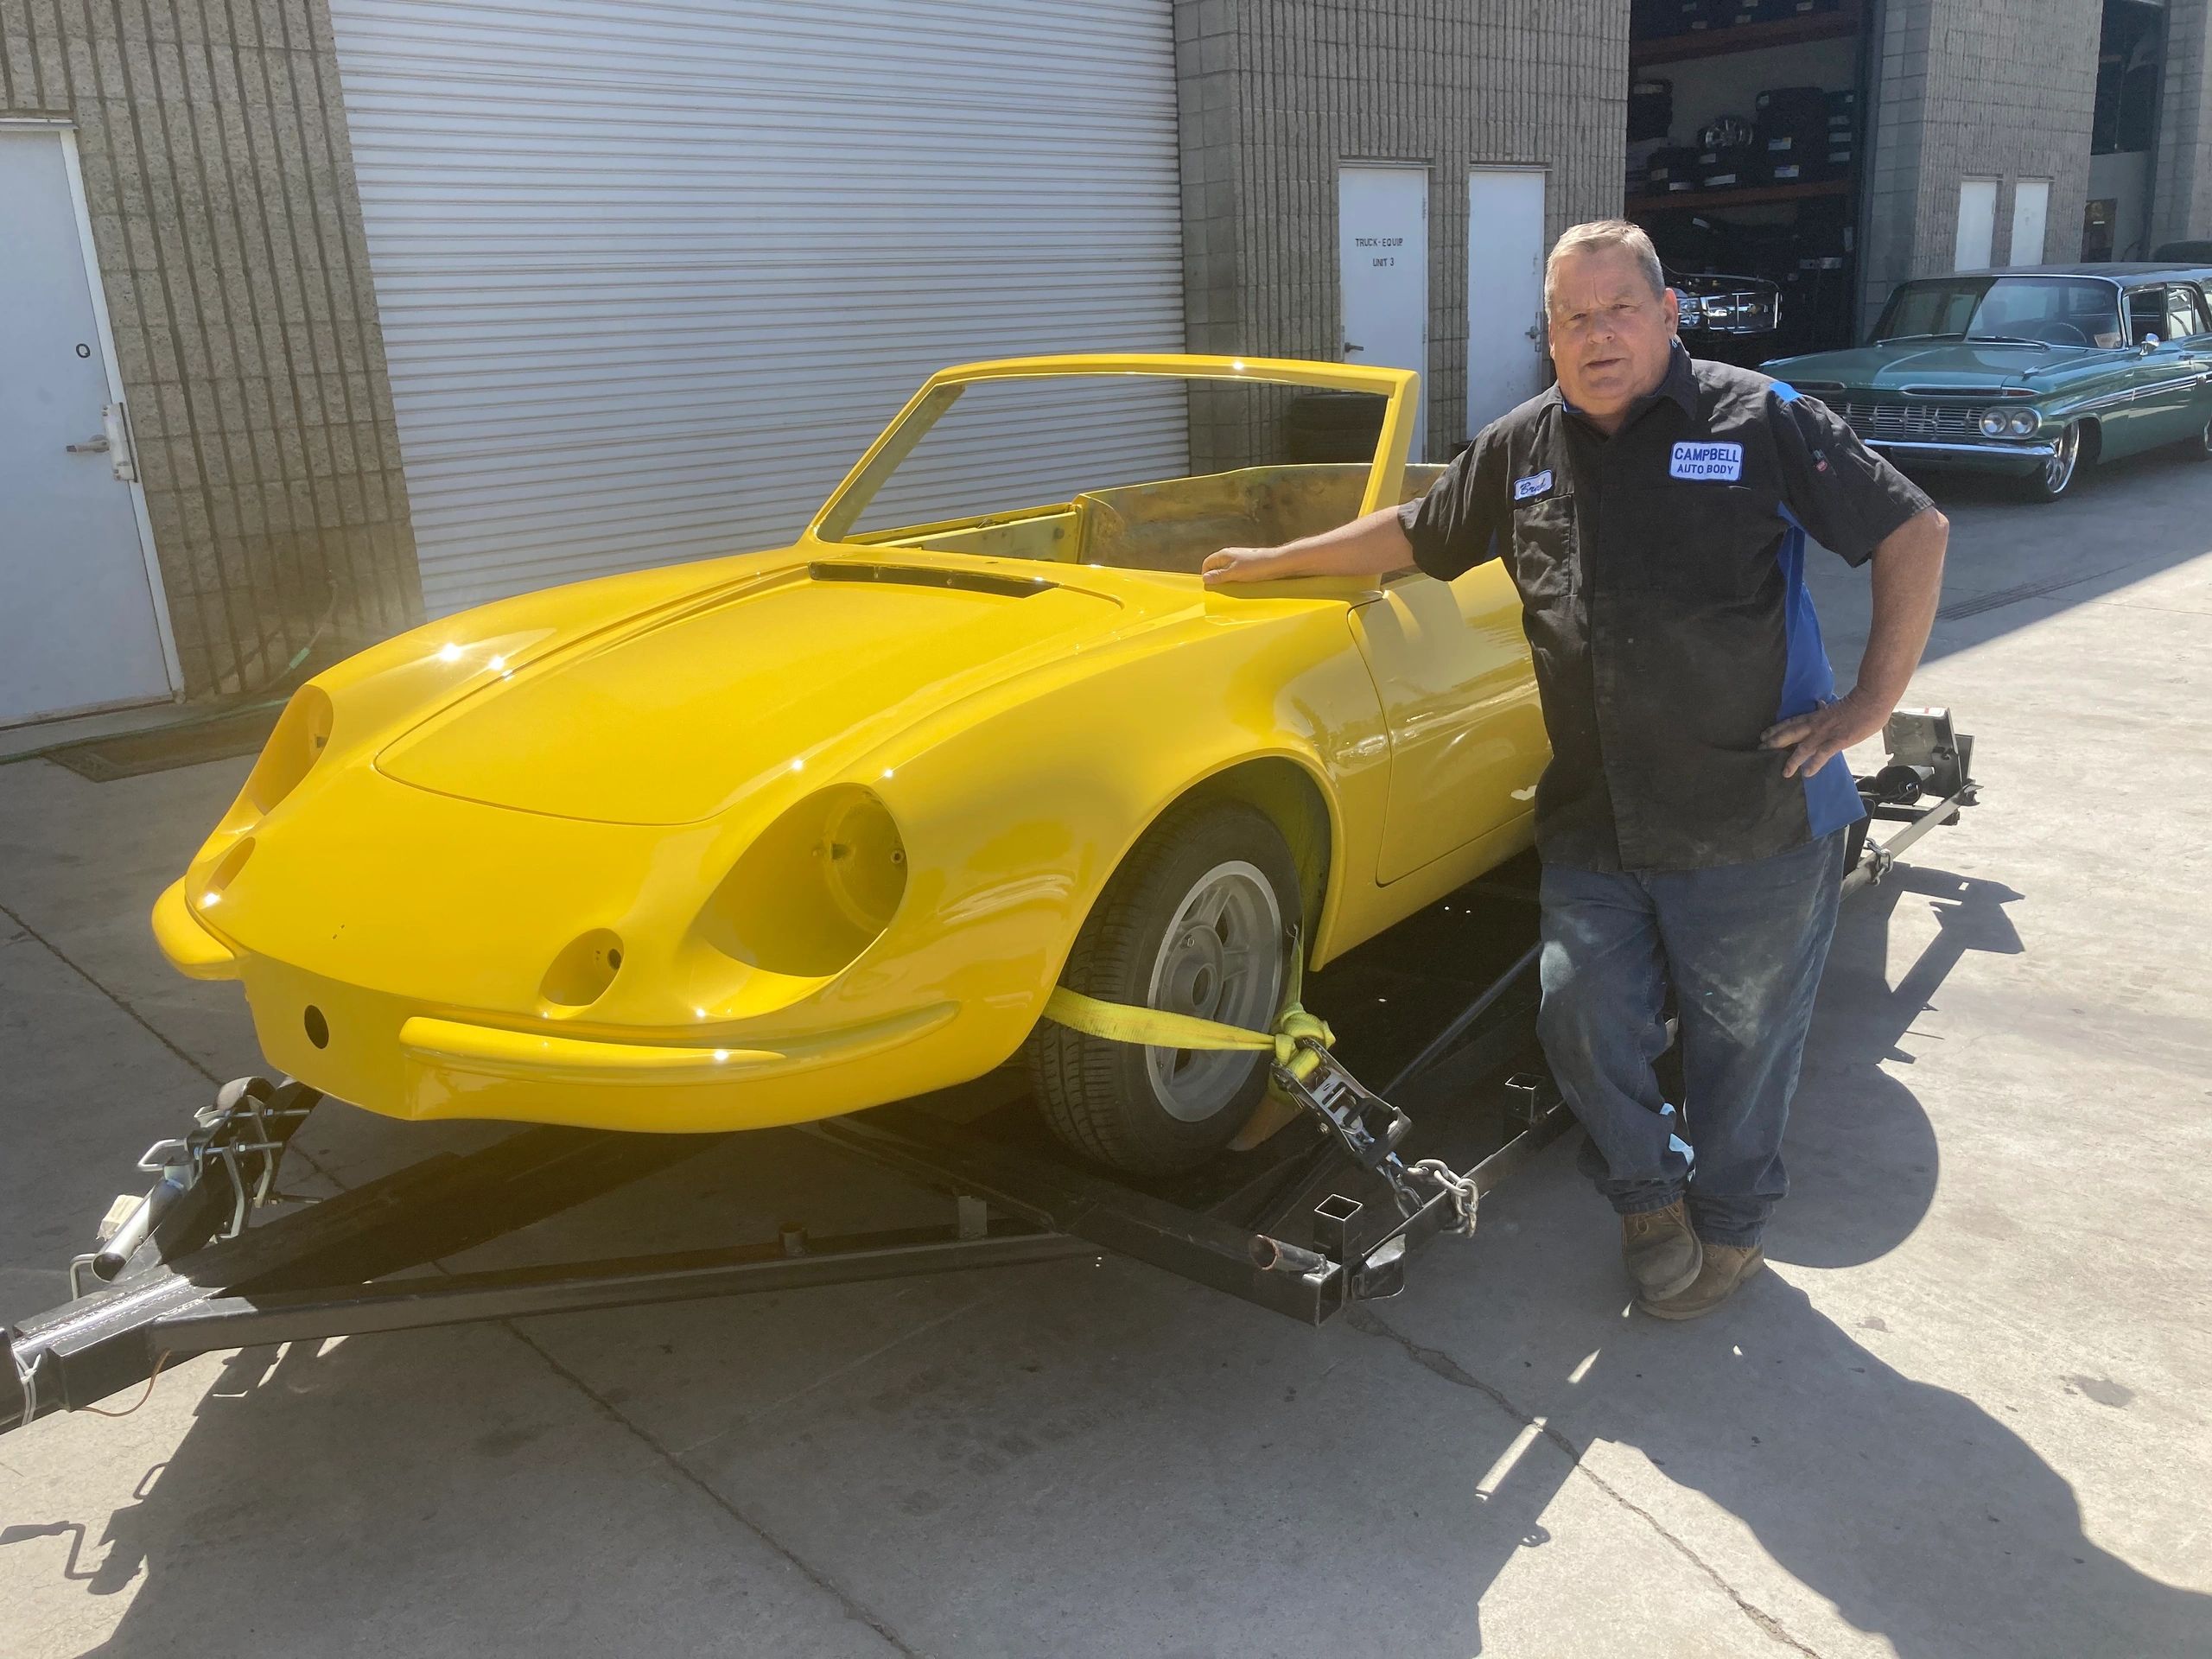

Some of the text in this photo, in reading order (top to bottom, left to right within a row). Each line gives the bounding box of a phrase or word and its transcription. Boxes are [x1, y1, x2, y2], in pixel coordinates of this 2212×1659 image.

[1372, 257, 1395, 267] UNIT 3
[1675, 448, 1739, 463] CAMPBELL
[1676, 464, 1734, 475] AUTO BODY
